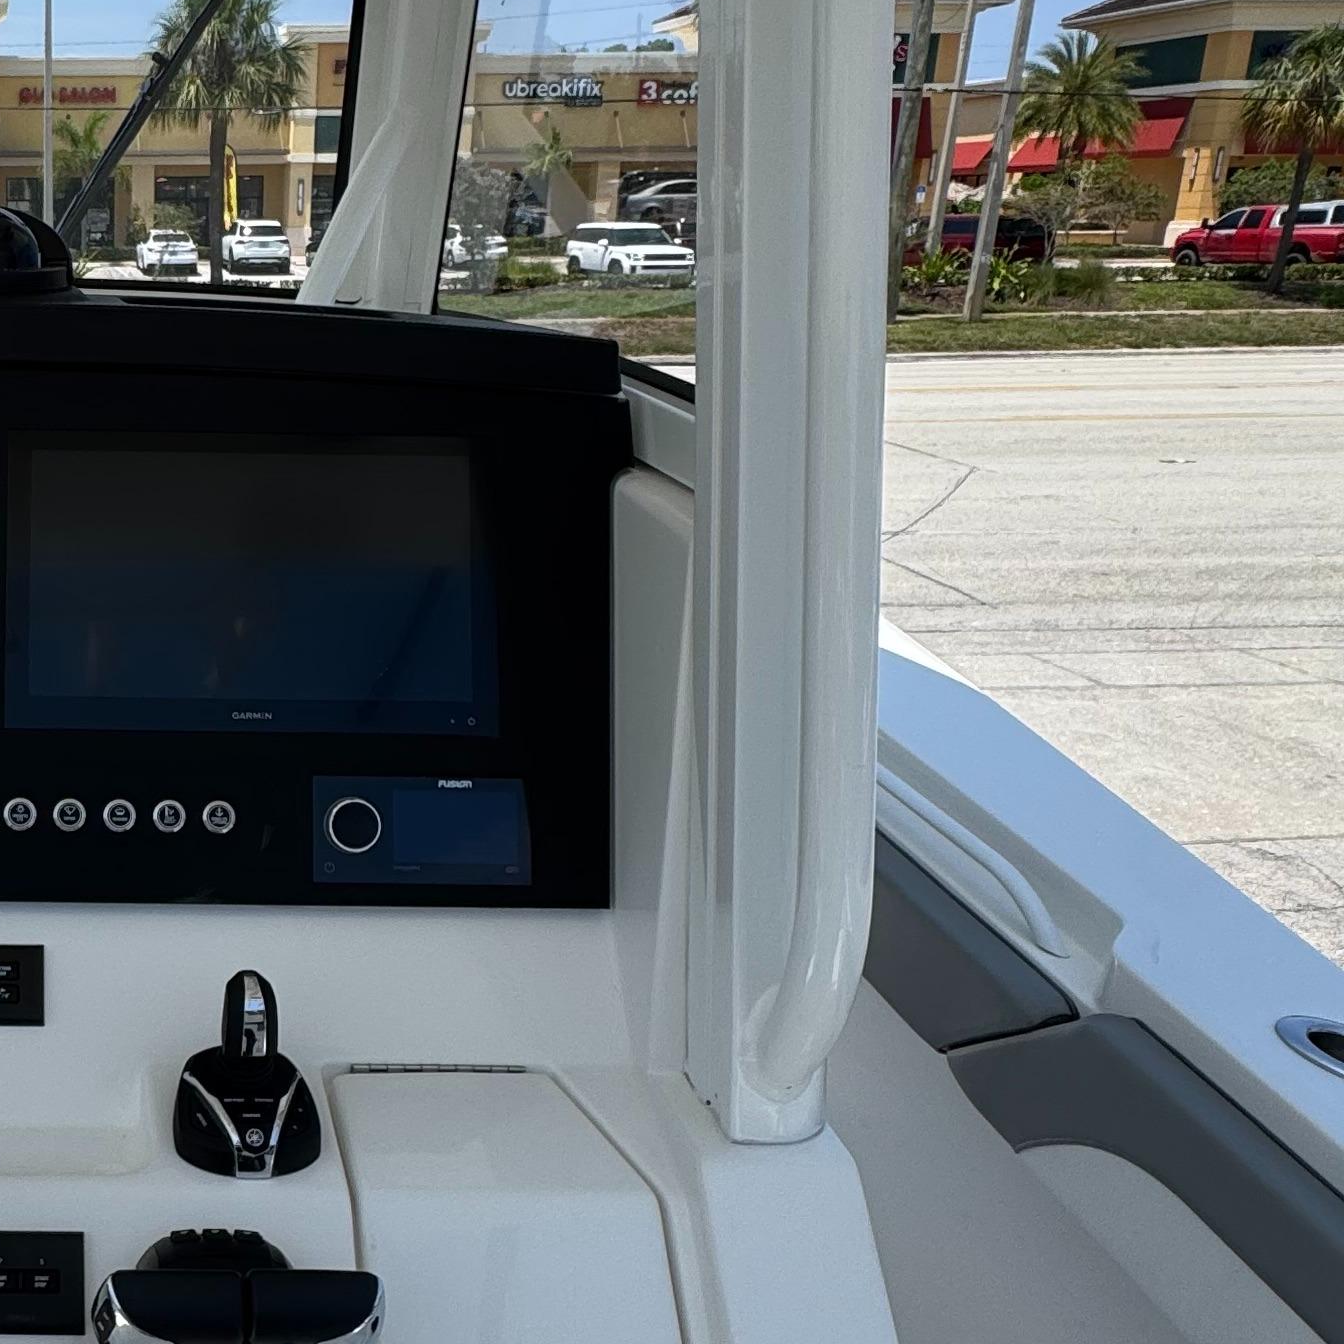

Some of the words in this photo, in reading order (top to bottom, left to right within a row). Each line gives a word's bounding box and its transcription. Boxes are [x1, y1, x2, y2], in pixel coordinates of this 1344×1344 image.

[504, 78, 602, 98] ubreakifix
[232, 711, 273, 720] GARMIN
[438, 779, 473, 788] FUSION
